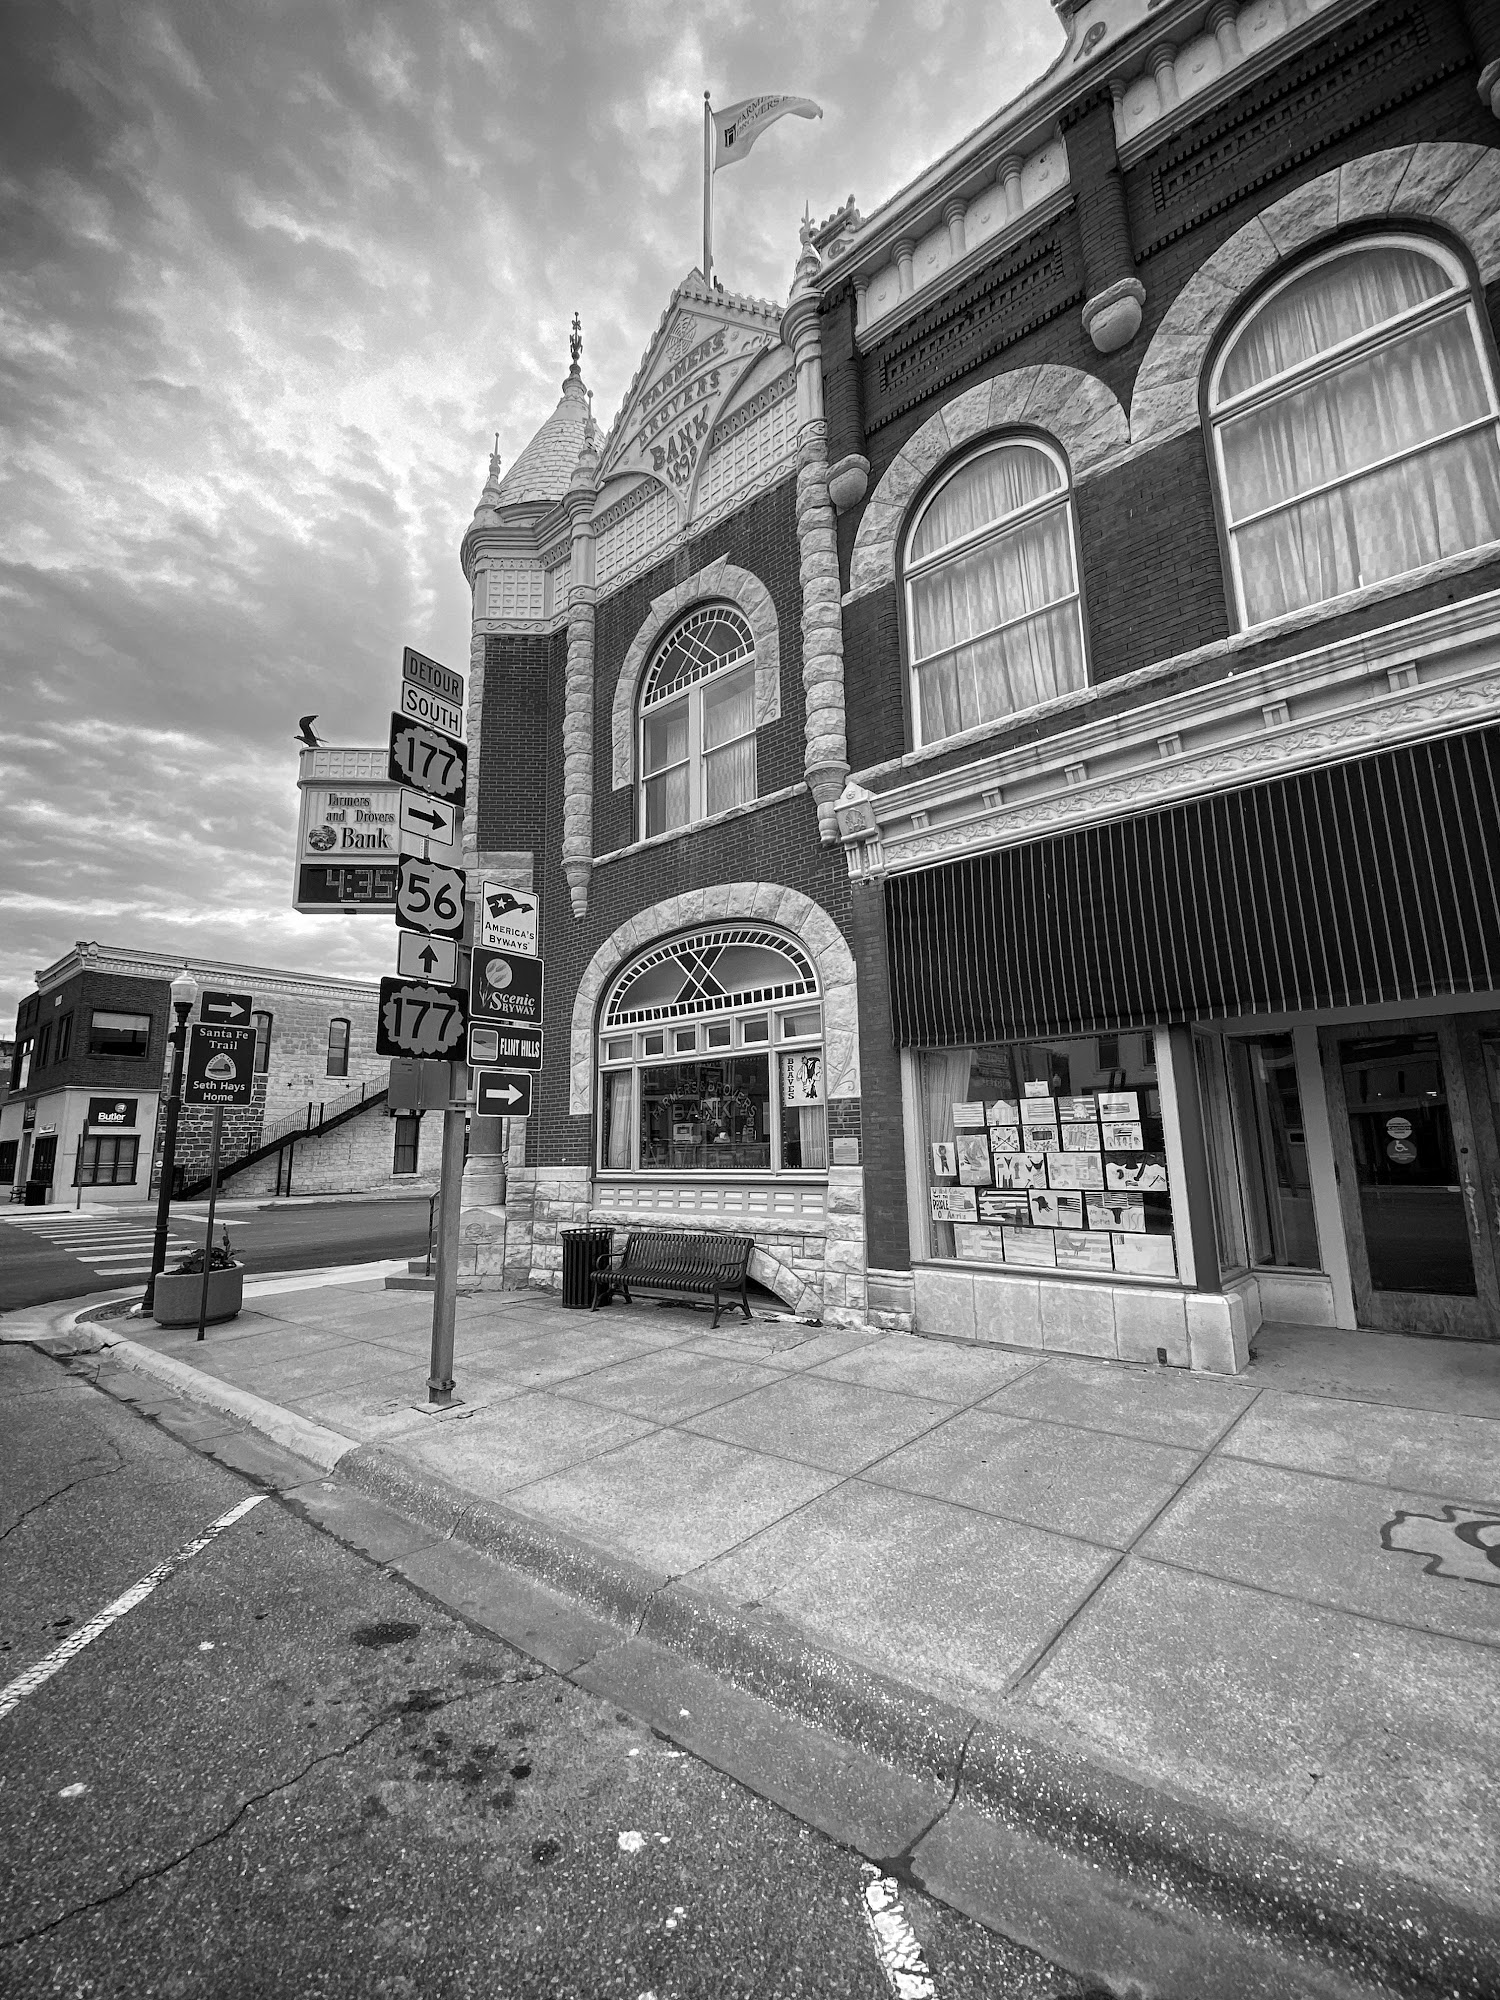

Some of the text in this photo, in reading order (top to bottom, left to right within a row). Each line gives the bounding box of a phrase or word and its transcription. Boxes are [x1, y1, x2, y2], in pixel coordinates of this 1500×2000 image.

[641, 330, 726, 413] FARMERS
[650, 404, 708, 471] BANK
[410, 656, 459, 697] DETOUR
[406, 689, 459, 732] SOUTH
[407, 737, 456, 785] 177
[328, 793, 371, 807] Farmers
[326, 809, 395, 823] and Drovers
[341, 827, 393, 849] Bank
[326, 869, 394, 898] 4:35
[406, 873, 457, 920] 56
[485, 921, 535, 940] AMERICA'S
[489, 991, 535, 1011] Scenic
[502, 1004, 536, 1016] BYWAY
[393, 997, 456, 1042] 177
[199, 1027, 249, 1040] Santa Fe
[208, 1040, 238, 1050] Trail
[500, 1037, 540, 1058] FLINT HILLS
[193, 1080, 246, 1093] Seth Hays
[787, 1057, 795, 1100] BRAVES
[203, 1092, 234, 1102] Home
[651, 1080, 758, 1120] FARMERS & DROVERS
[98, 1112, 126, 1121] Butler
[672, 1100, 733, 1121] BANK
